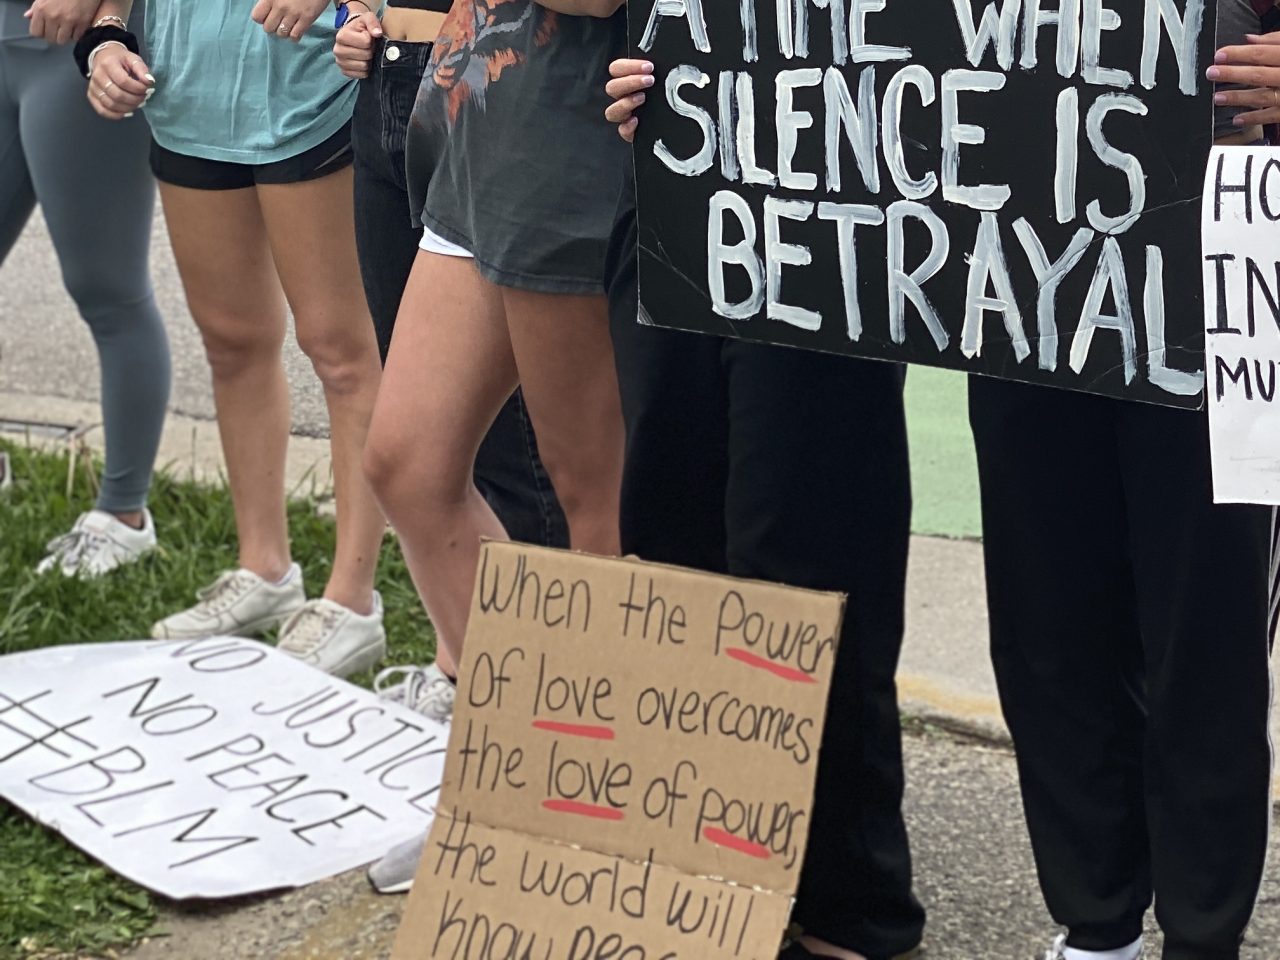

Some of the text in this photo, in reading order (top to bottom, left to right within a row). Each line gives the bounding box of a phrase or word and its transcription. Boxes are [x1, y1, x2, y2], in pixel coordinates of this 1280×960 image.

[653, 64, 1149, 234] SILENCE IS
[707, 190, 1204, 395] BETRAYAL
[479, 548, 591, 633] When
[619, 572, 687, 645] the
[102, 676, 388, 847] NO PEACE
[458, 718, 526, 791] the
[547, 740, 632, 808] love
[643, 760, 697, 828] of
[533, 652, 616, 721] love
[637, 687, 813, 764] overcomes
[0, 689, 260, 869] #BLM
[434, 805, 497, 887] the
[520, 848, 654, 918] world
